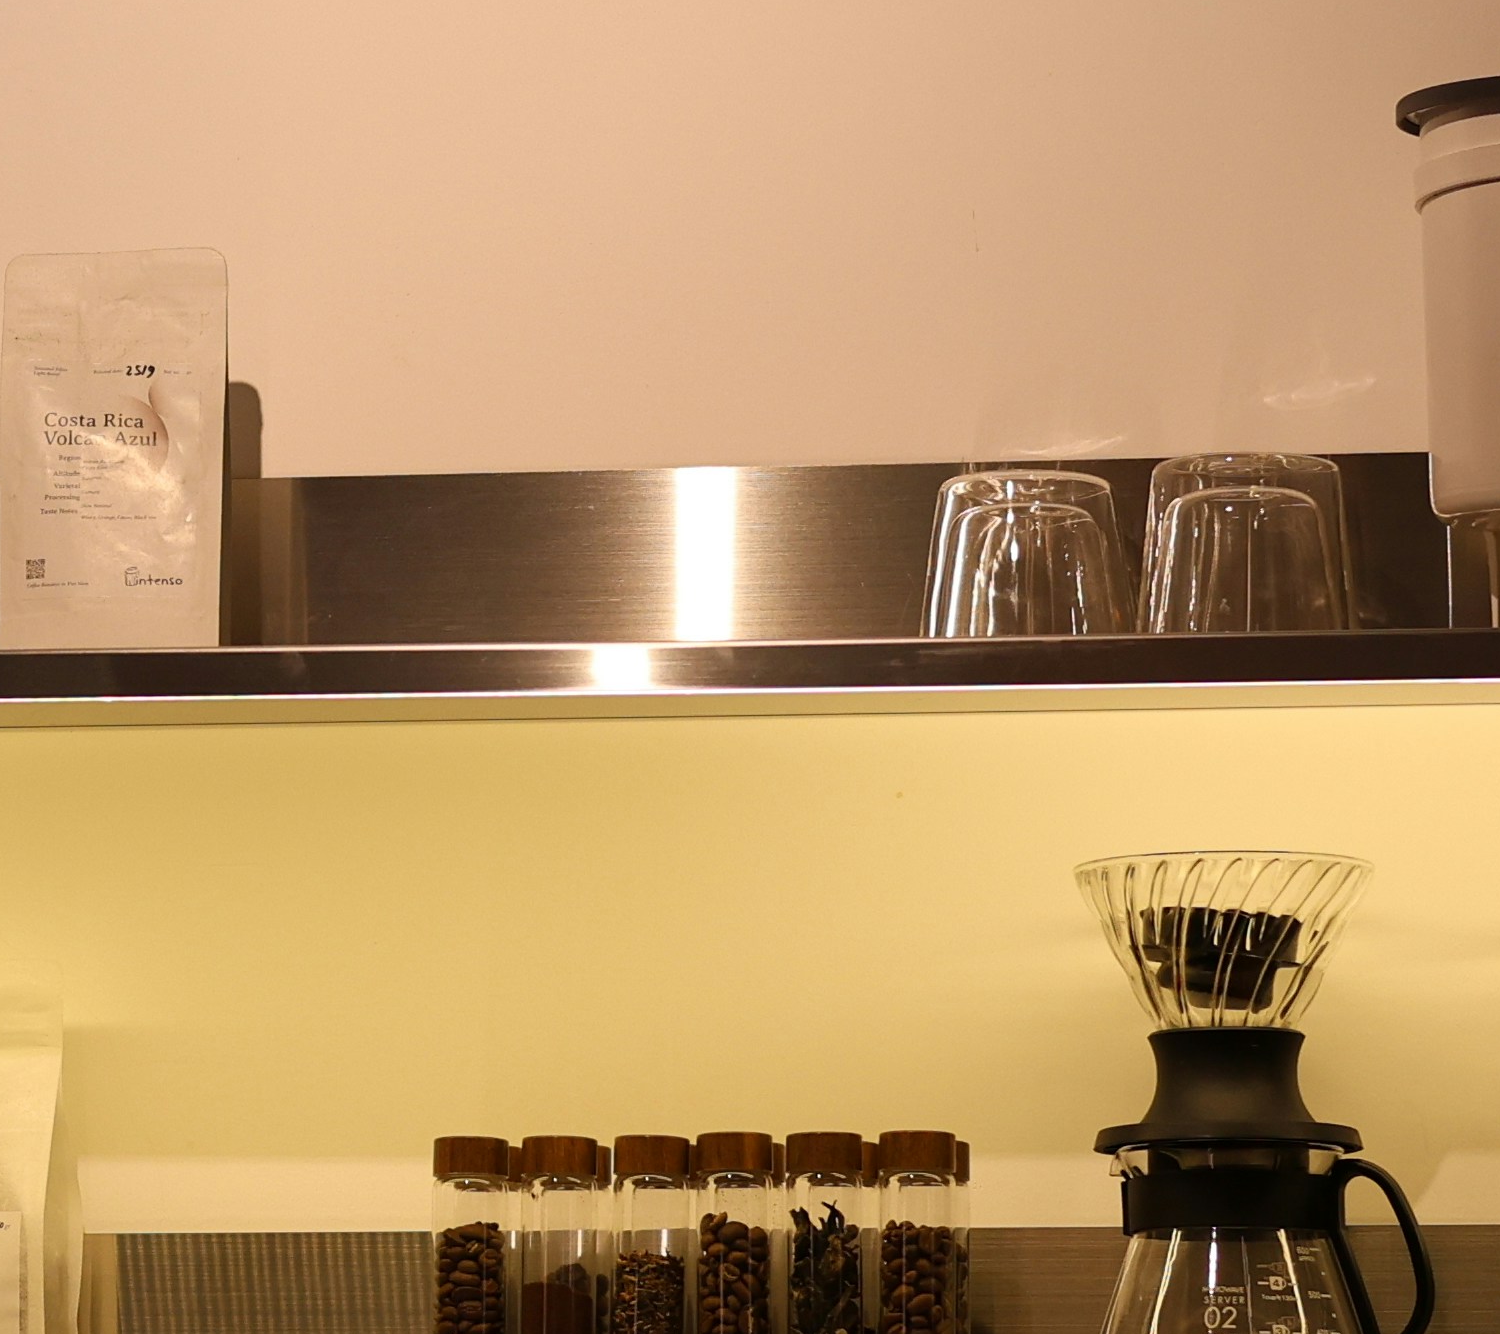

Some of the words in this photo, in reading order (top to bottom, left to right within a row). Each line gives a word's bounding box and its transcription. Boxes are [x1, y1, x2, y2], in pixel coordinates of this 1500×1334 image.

[43, 412, 97, 429] Costa
[103, 412, 144, 429] Rica
[115, 430, 158, 447] Azul
[44, 493, 80, 502] Processing
[1203, 1295, 1245, 1304] SERVER
[1204, 1306, 1237, 1329] 02
